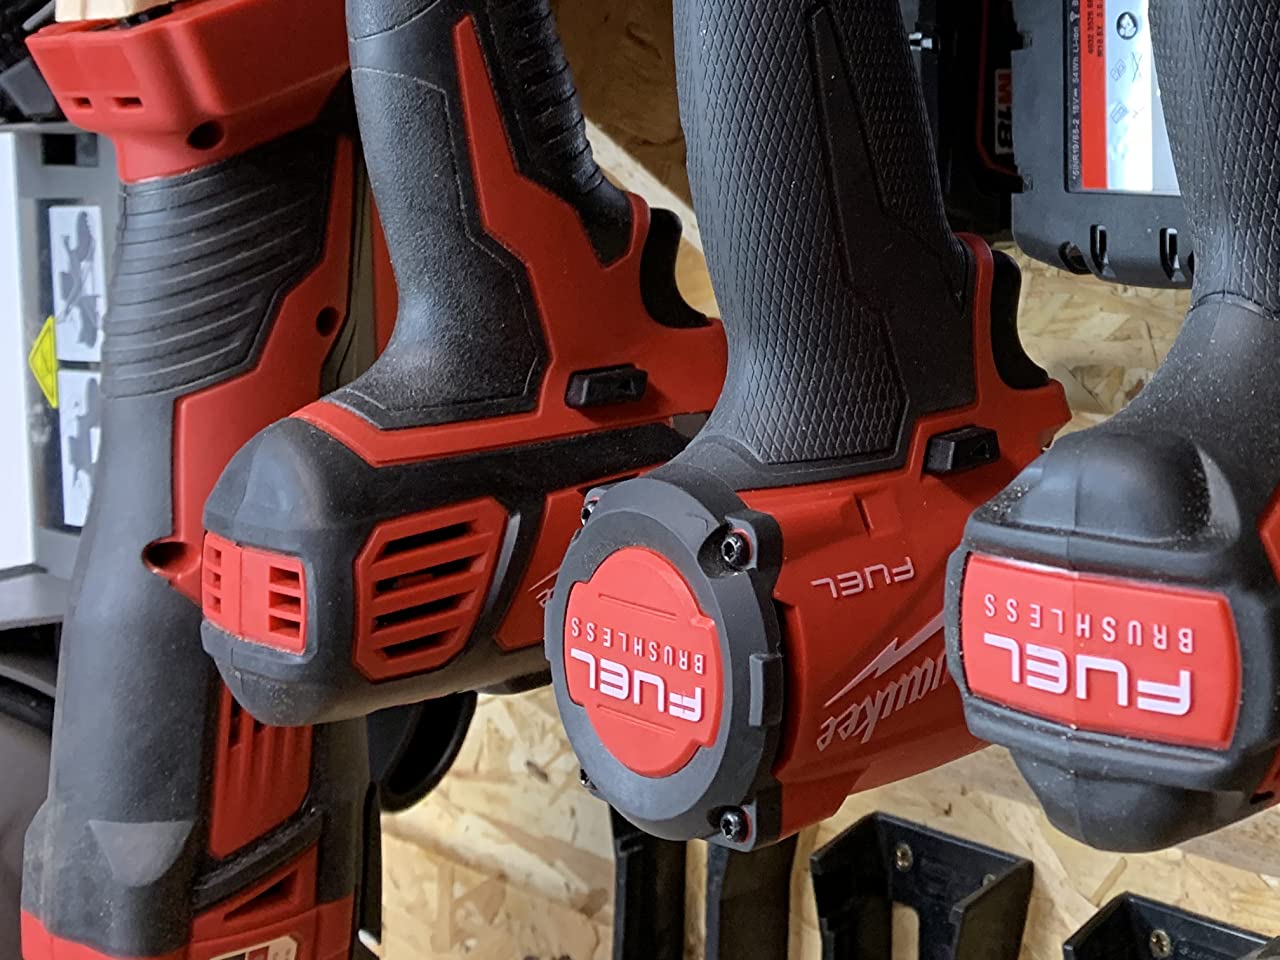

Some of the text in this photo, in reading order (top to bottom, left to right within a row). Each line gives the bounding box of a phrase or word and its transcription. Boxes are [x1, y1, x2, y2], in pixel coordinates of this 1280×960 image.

[998, 73, 1011, 148] M18
[810, 557, 914, 598] FUEL
[571, 617, 704, 675] BRUSHLESS
[982, 592, 1192, 652] BRUSHLESS
[570, 648, 704, 723] FUEL
[984, 632, 1192, 716] FUEL
